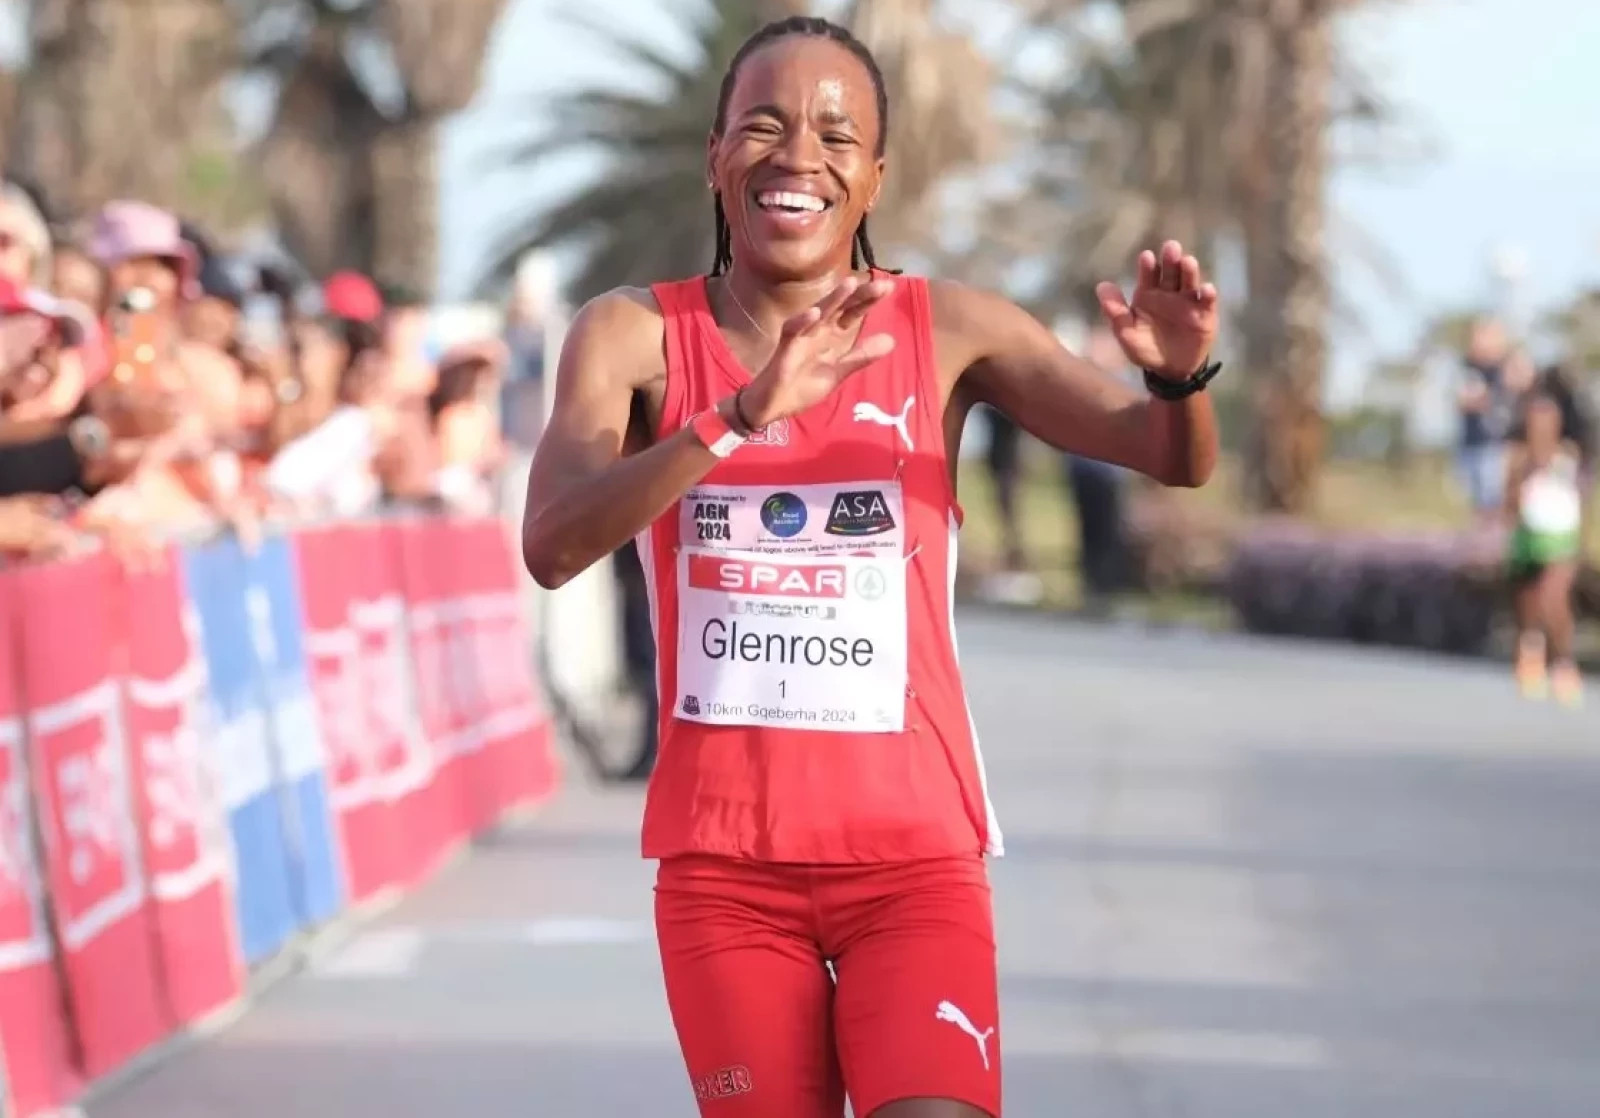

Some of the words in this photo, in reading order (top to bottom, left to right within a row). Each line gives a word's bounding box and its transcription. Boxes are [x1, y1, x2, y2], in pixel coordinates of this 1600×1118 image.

[693, 503, 730, 520] AGN
[834, 496, 885, 518] ASA
[697, 522, 731, 541] 2024
[719, 563, 843, 593] SPAR
[702, 617, 874, 667] Glenrose
[777, 679, 786, 699] 1
[706, 701, 742, 717] 10km
[747, 703, 817, 722] Gqeberha
[821, 708, 856, 723] 2024
